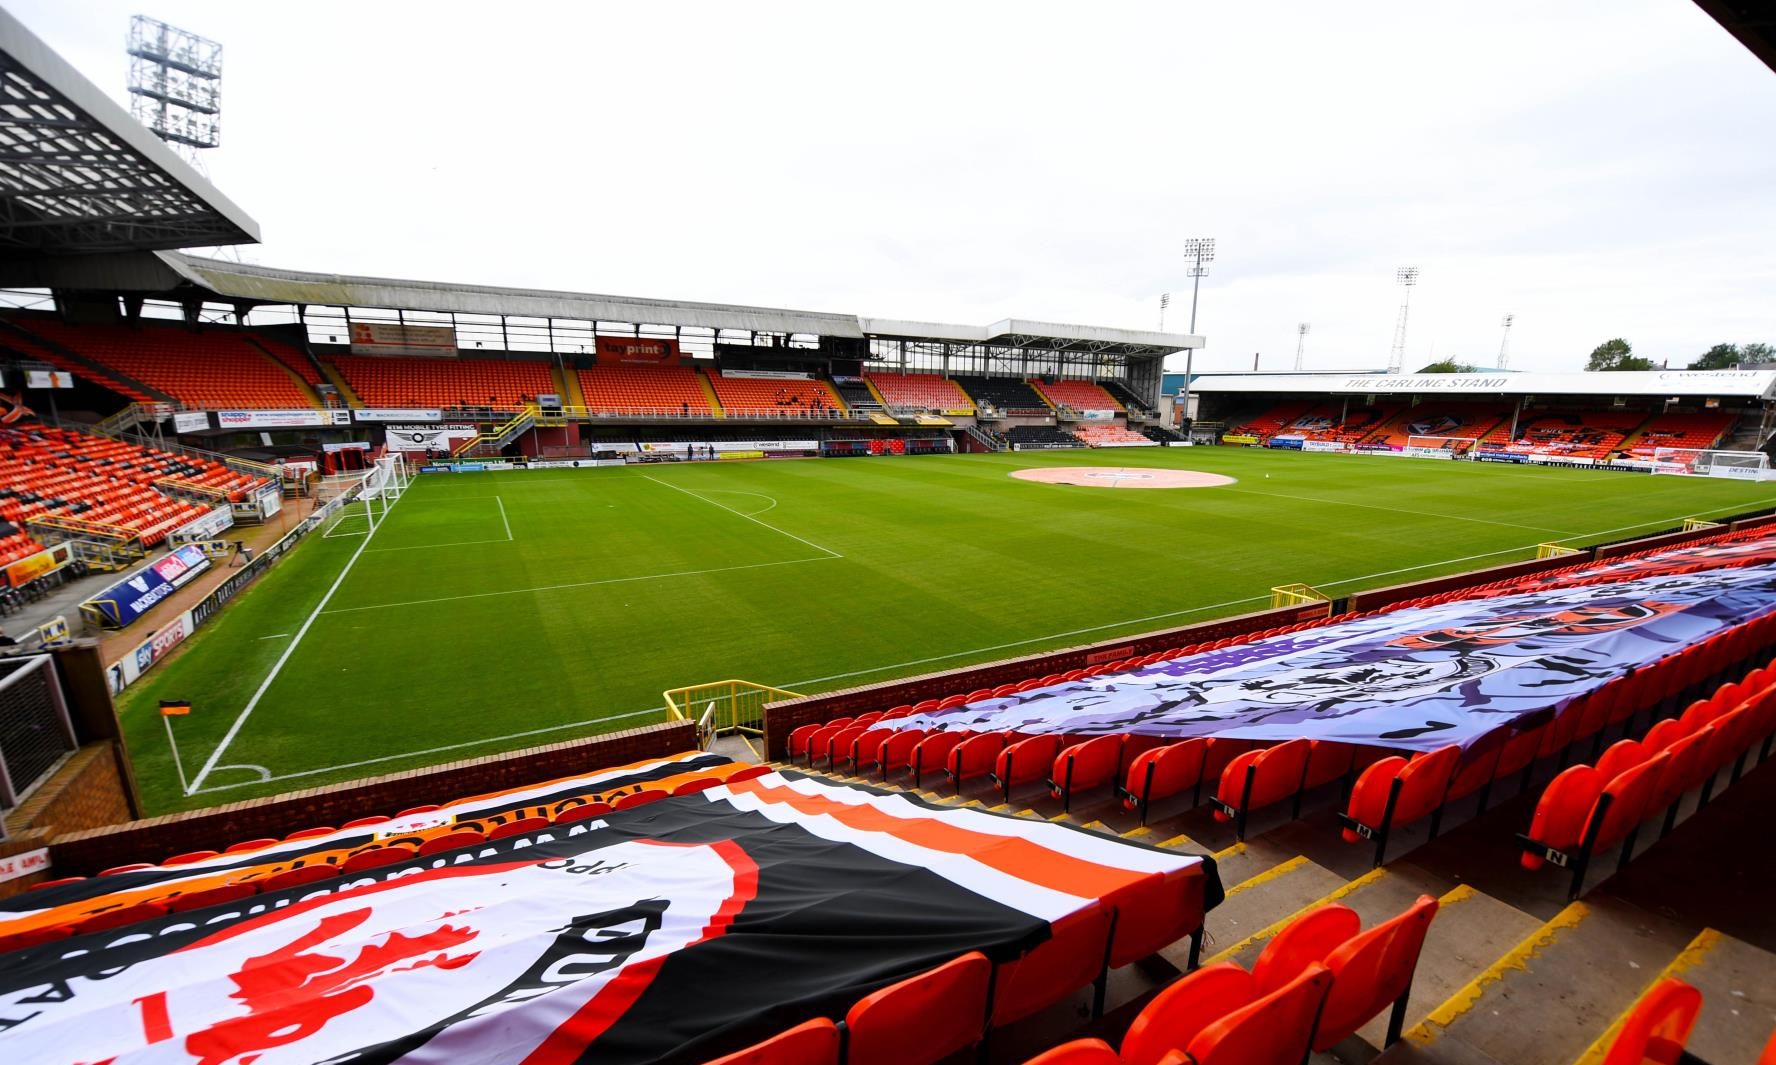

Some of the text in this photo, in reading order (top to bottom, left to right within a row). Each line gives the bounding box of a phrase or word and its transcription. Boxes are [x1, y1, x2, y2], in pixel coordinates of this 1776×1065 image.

[1345, 379, 1508, 387] THE CARLING STAND
[153, 619, 184, 657] SPORTS
